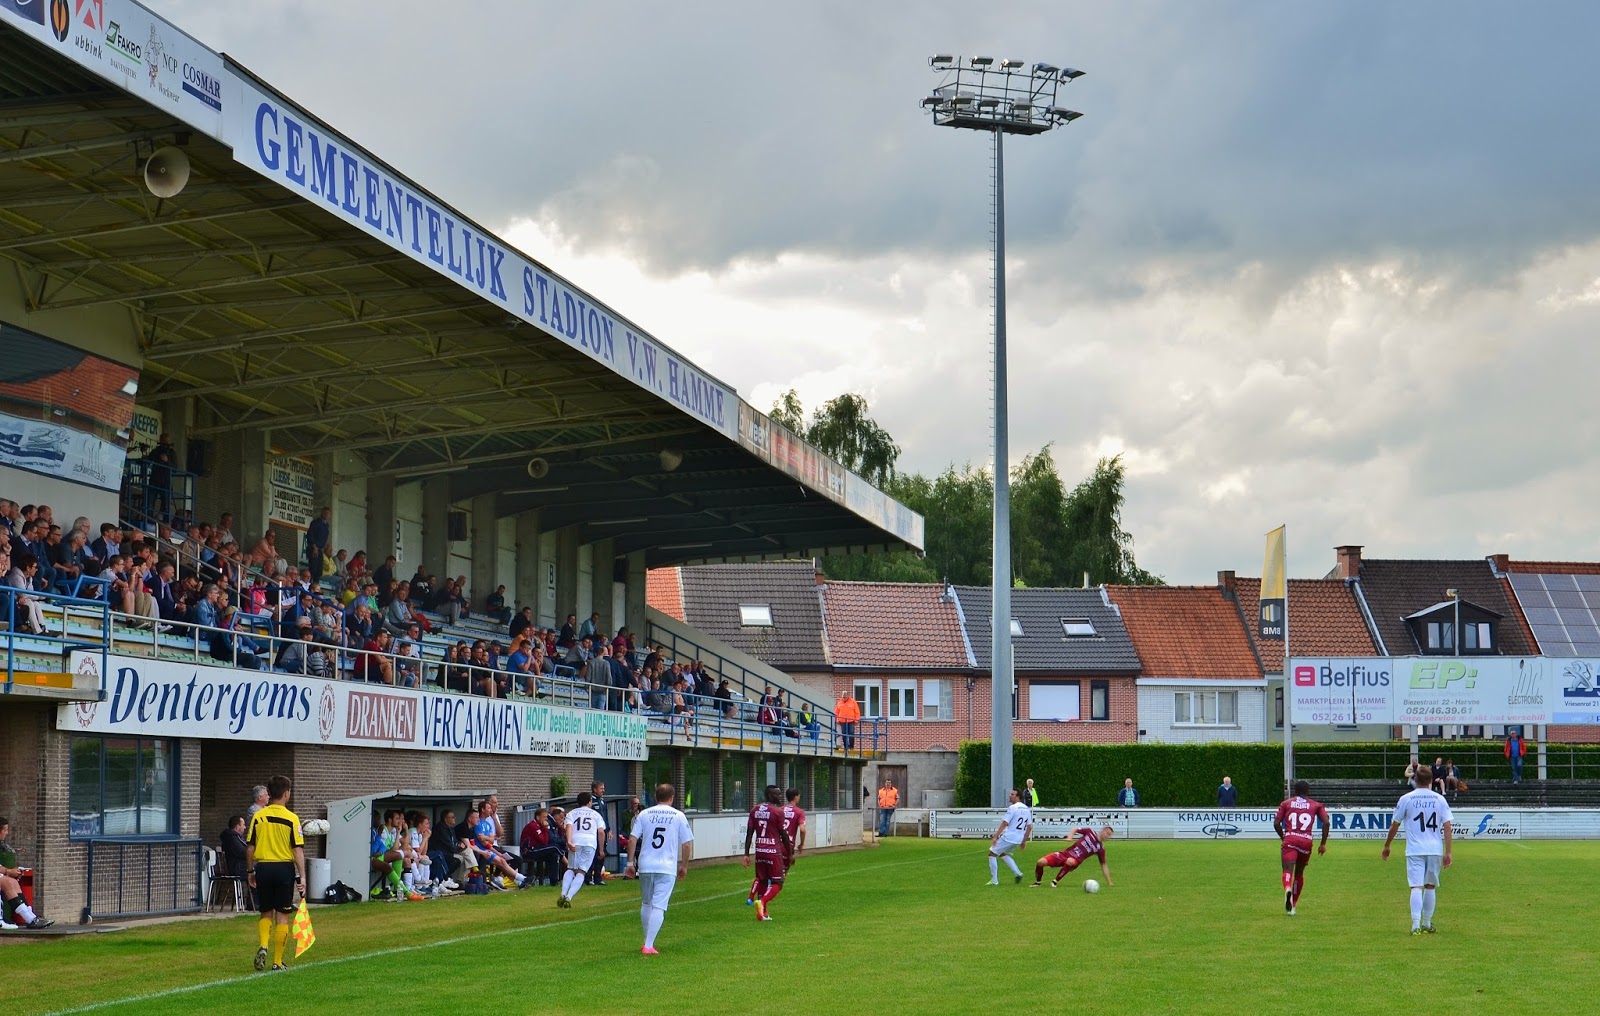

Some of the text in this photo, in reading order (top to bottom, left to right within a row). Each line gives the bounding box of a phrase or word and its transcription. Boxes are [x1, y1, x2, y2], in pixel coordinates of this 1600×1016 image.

[75, 35, 103, 60] ubbink
[117, 34, 141, 59] FAKRO
[162, 52, 178, 74] NCP
[183, 62, 221, 99] COSMAR
[158, 81, 180, 103] Workwear
[255, 102, 507, 302] GEMEENTELIJK
[523, 265, 615, 365] STADION
[625, 331, 663, 393] V.W.
[667, 357, 725, 429] HAMME
[1320, 666, 1390, 687] Belfius
[1409, 661, 1479, 689] EP:
[108, 667, 312, 734] Dentergems
[1406, 706, 1473, 715] 052/46.39.61
[1507, 696, 1544, 705] ELECTRONICS
[349, 694, 524, 751] DRANKEN VERCAMMEN
[525, 706, 549, 732] HOUT
[584, 712, 628, 739] VANDEWALLE
[1312, 713, 1330, 721] 052
[1332, 713, 1344, 721] 26
[1360, 713, 1372, 721] 50
[1424, 714, 1456, 722] service
[1413, 799, 1436, 809] Bart
[573, 816, 592, 831] 15
[649, 814, 674, 825] Bart
[1016, 817, 1028, 831] 21
[1178, 813, 1276, 822] KRAANVERHUUR
[1288, 812, 1312, 831] 19
[1413, 811, 1438, 833] 14
[651, 827, 666, 850] 5
[758, 820, 767, 837] 7
